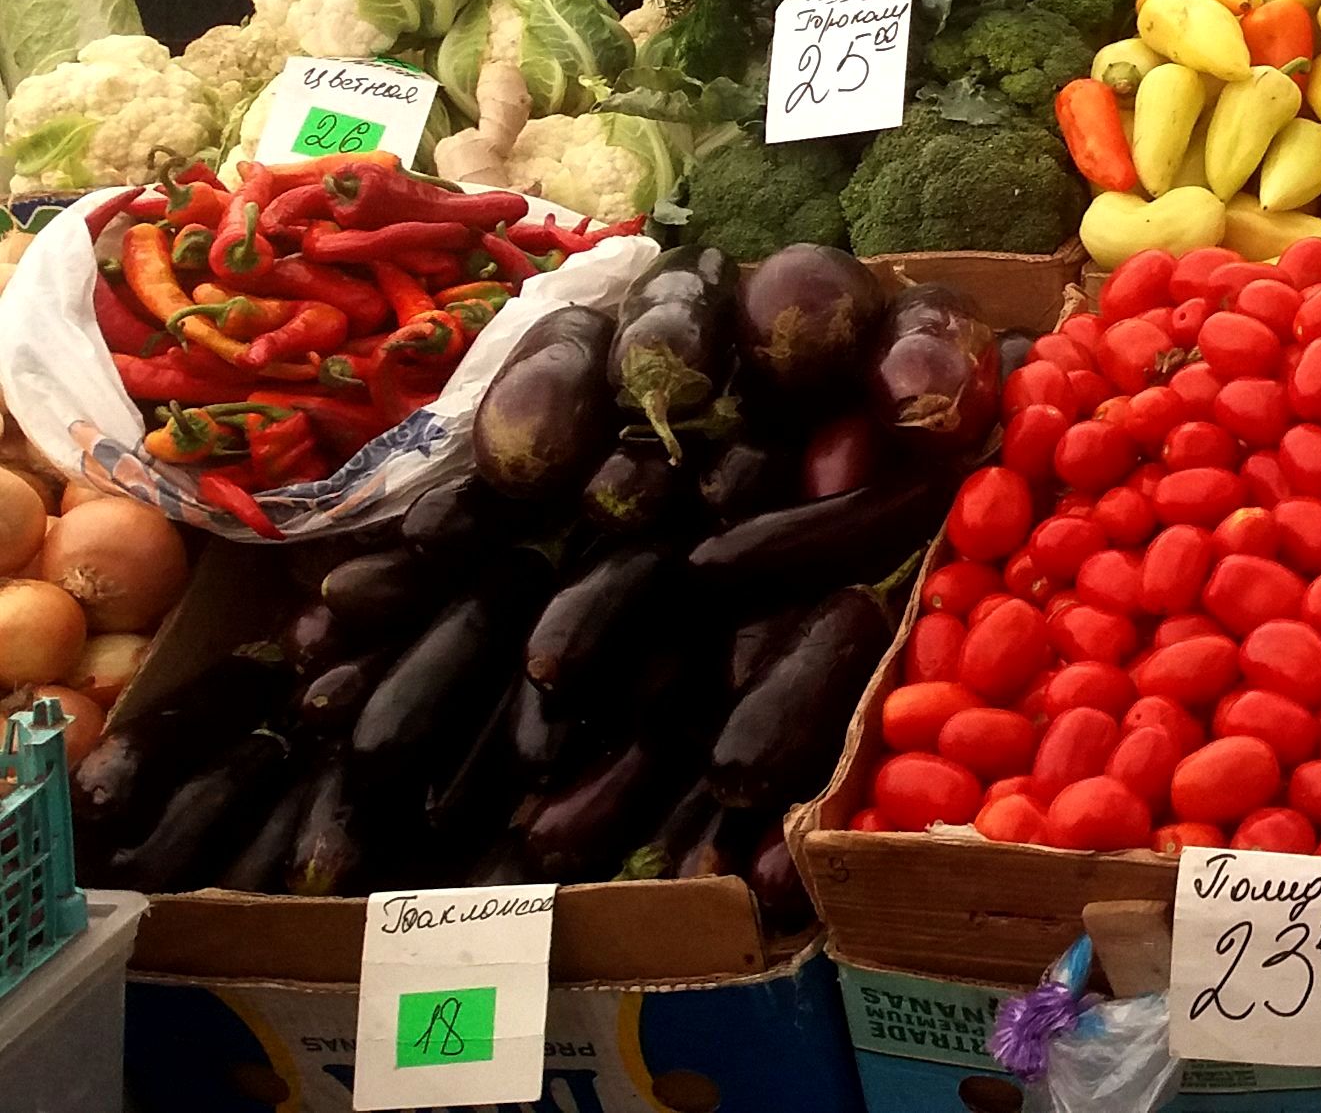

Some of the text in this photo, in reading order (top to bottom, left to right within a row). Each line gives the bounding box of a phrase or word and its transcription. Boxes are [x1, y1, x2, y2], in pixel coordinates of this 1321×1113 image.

[785, 33, 871, 114] 25
[305, 114, 370, 153] 26
[1190, 920, 1315, 1021] 23
[414, 996, 464, 1056] 18
